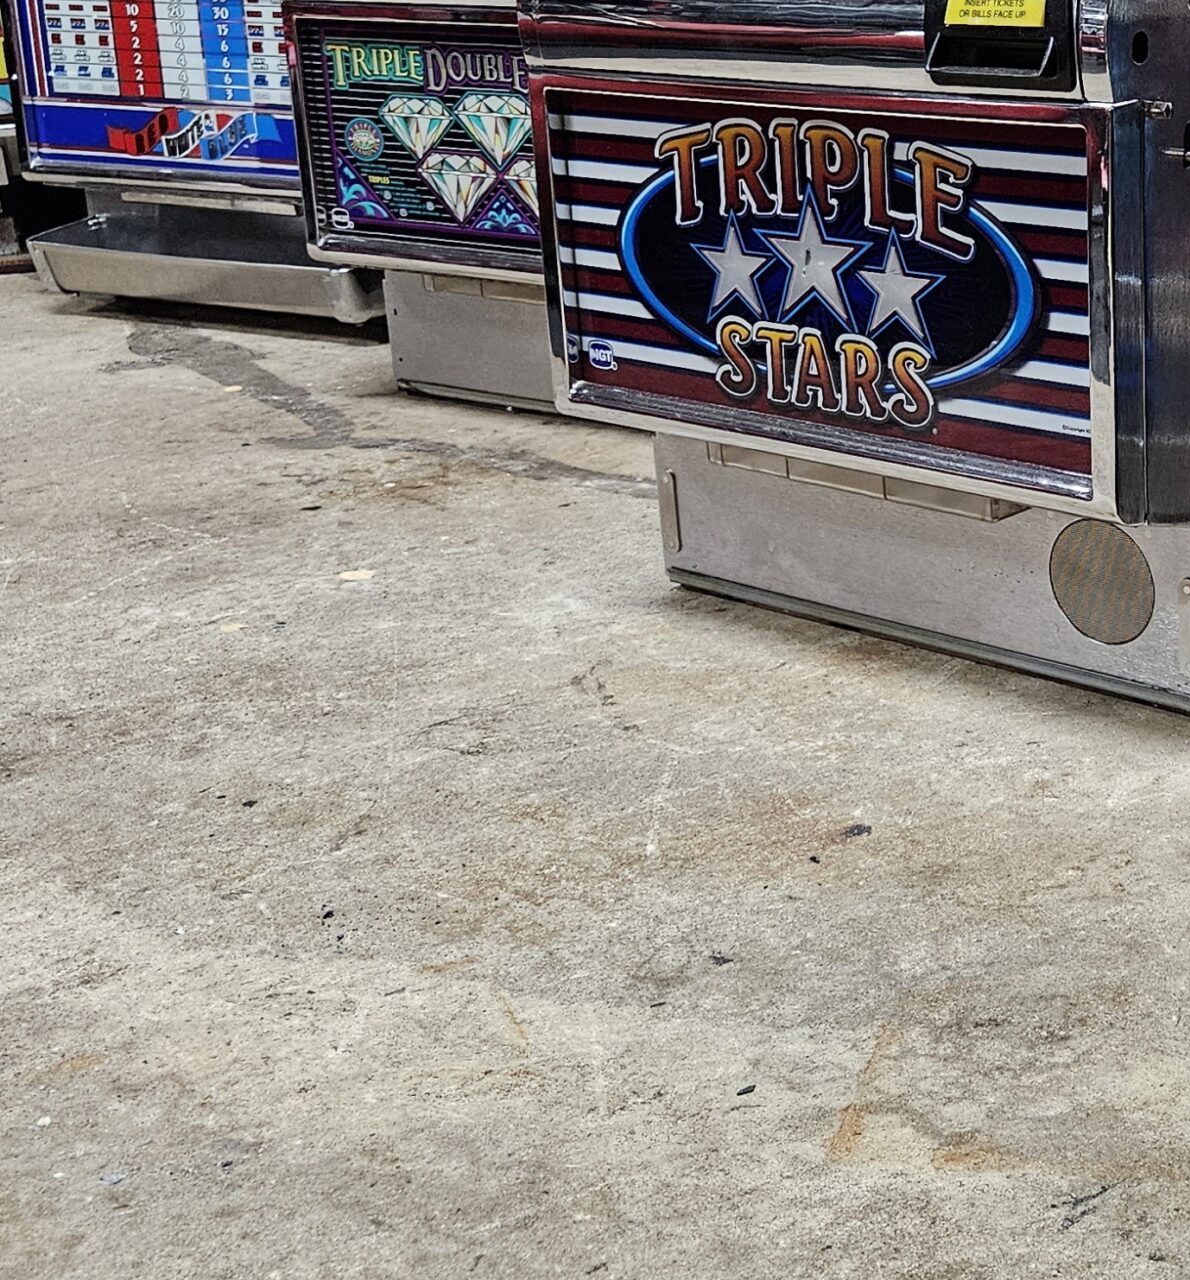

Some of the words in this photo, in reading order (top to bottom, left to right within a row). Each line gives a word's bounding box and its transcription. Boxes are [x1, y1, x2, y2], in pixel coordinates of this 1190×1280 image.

[959, 9, 970, 18] OR
[971, 9, 992, 18] BILLS
[993, 9, 1013, 19] FACE
[1014, 10, 1026, 19] UP
[325, 42, 425, 88] TRIPLE
[655, 116, 977, 263] TRIPLE
[714, 315, 935, 428] STARS
